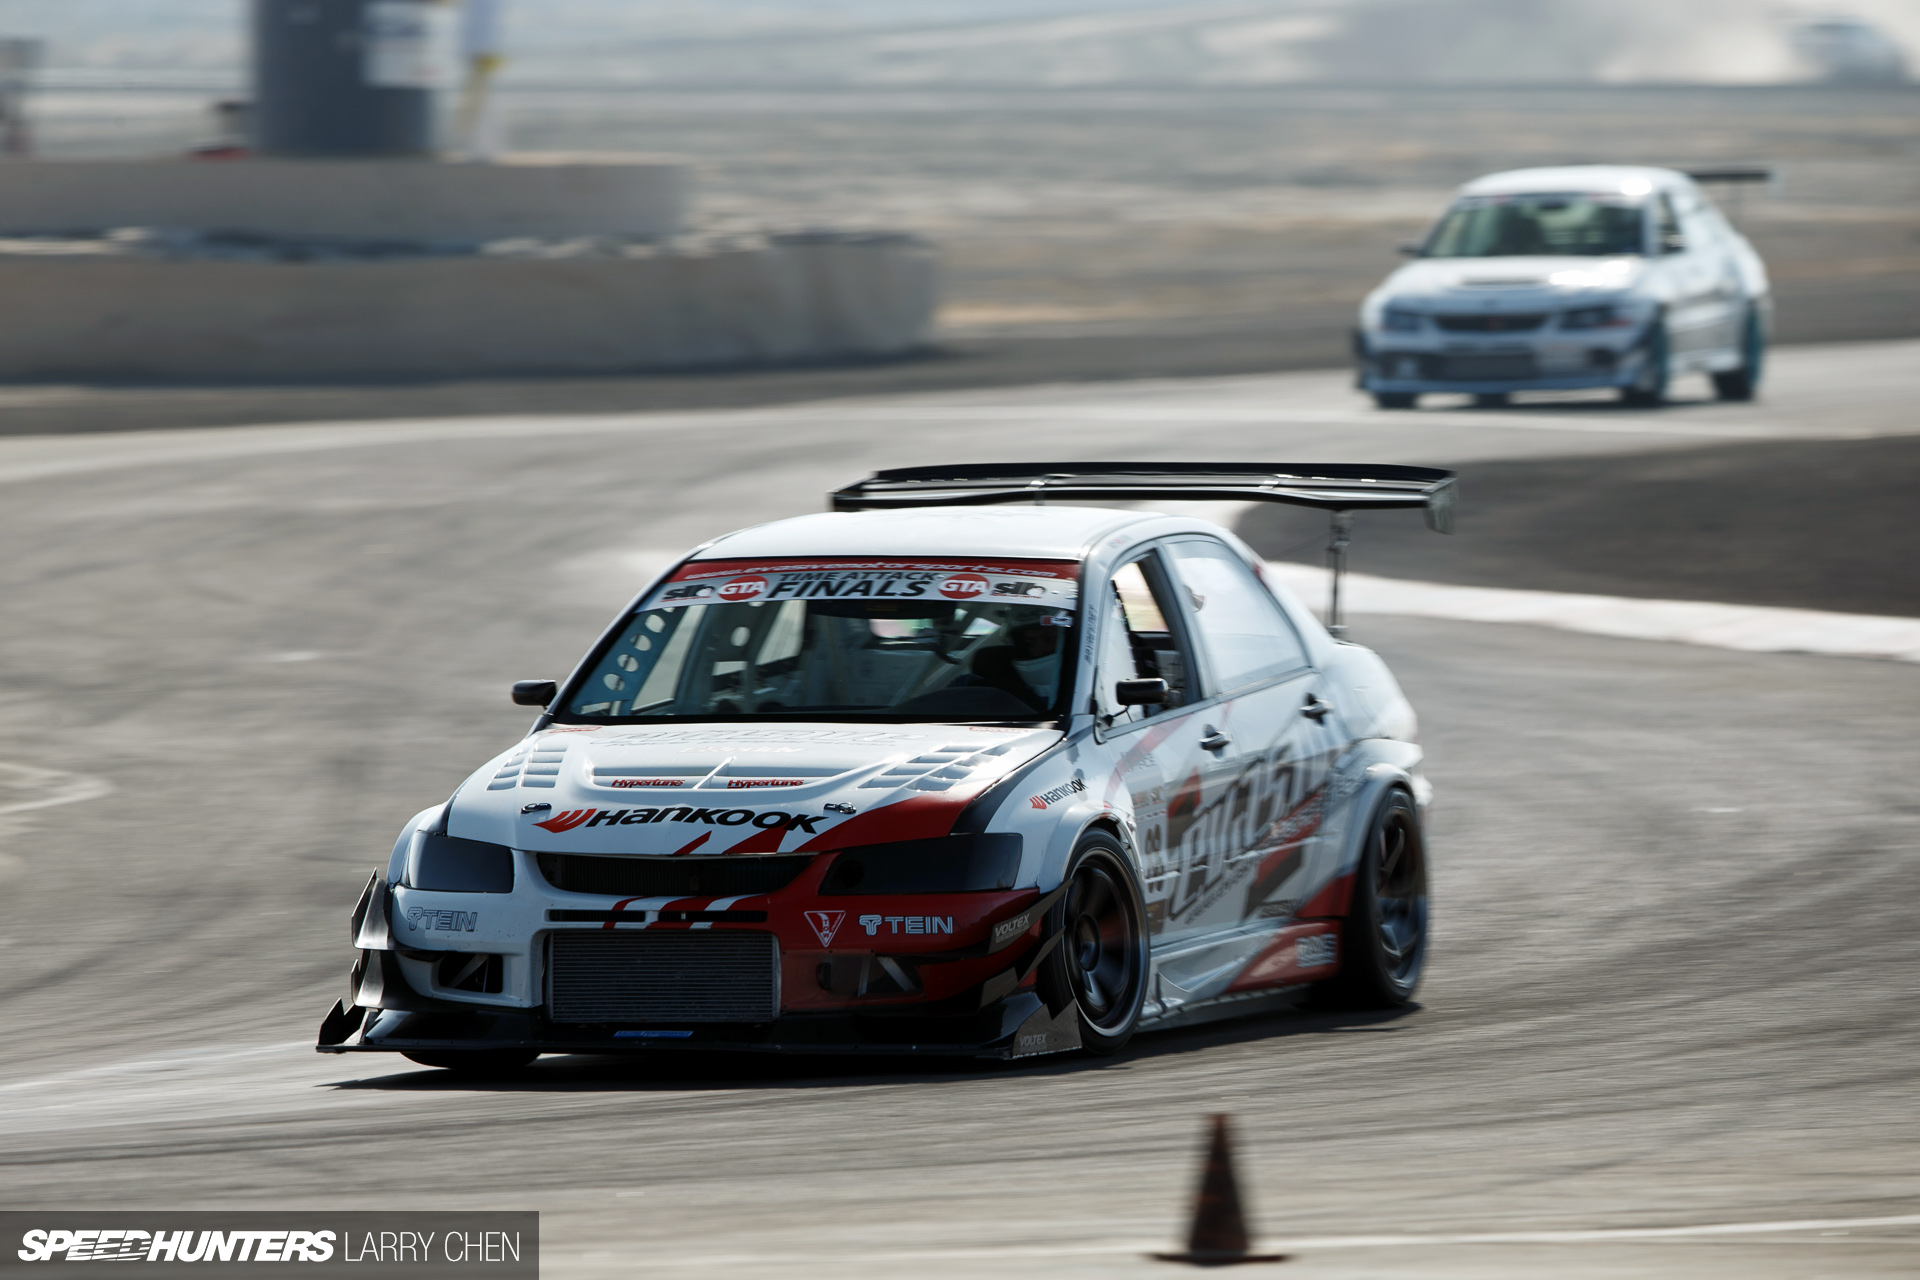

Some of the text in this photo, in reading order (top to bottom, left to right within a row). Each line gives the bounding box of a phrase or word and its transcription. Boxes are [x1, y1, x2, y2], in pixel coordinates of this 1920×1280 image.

[684, 562, 1057, 580] www.evasivemotorsports.com
[779, 571, 938, 581] TIME ATTACK
[718, 580, 767, 596] GTA
[765, 580, 932, 598] FINALS
[938, 579, 988, 594] GTA
[611, 778, 686, 789] Hypertune
[727, 778, 805, 789] Hypertune
[422, 910, 478, 932] TEIN
[822, 919, 830, 938] TOW
[884, 915, 953, 935] TEIN
[995, 913, 1030, 937] VOLTEX
[1019, 1033, 1047, 1047] VOLTEX
